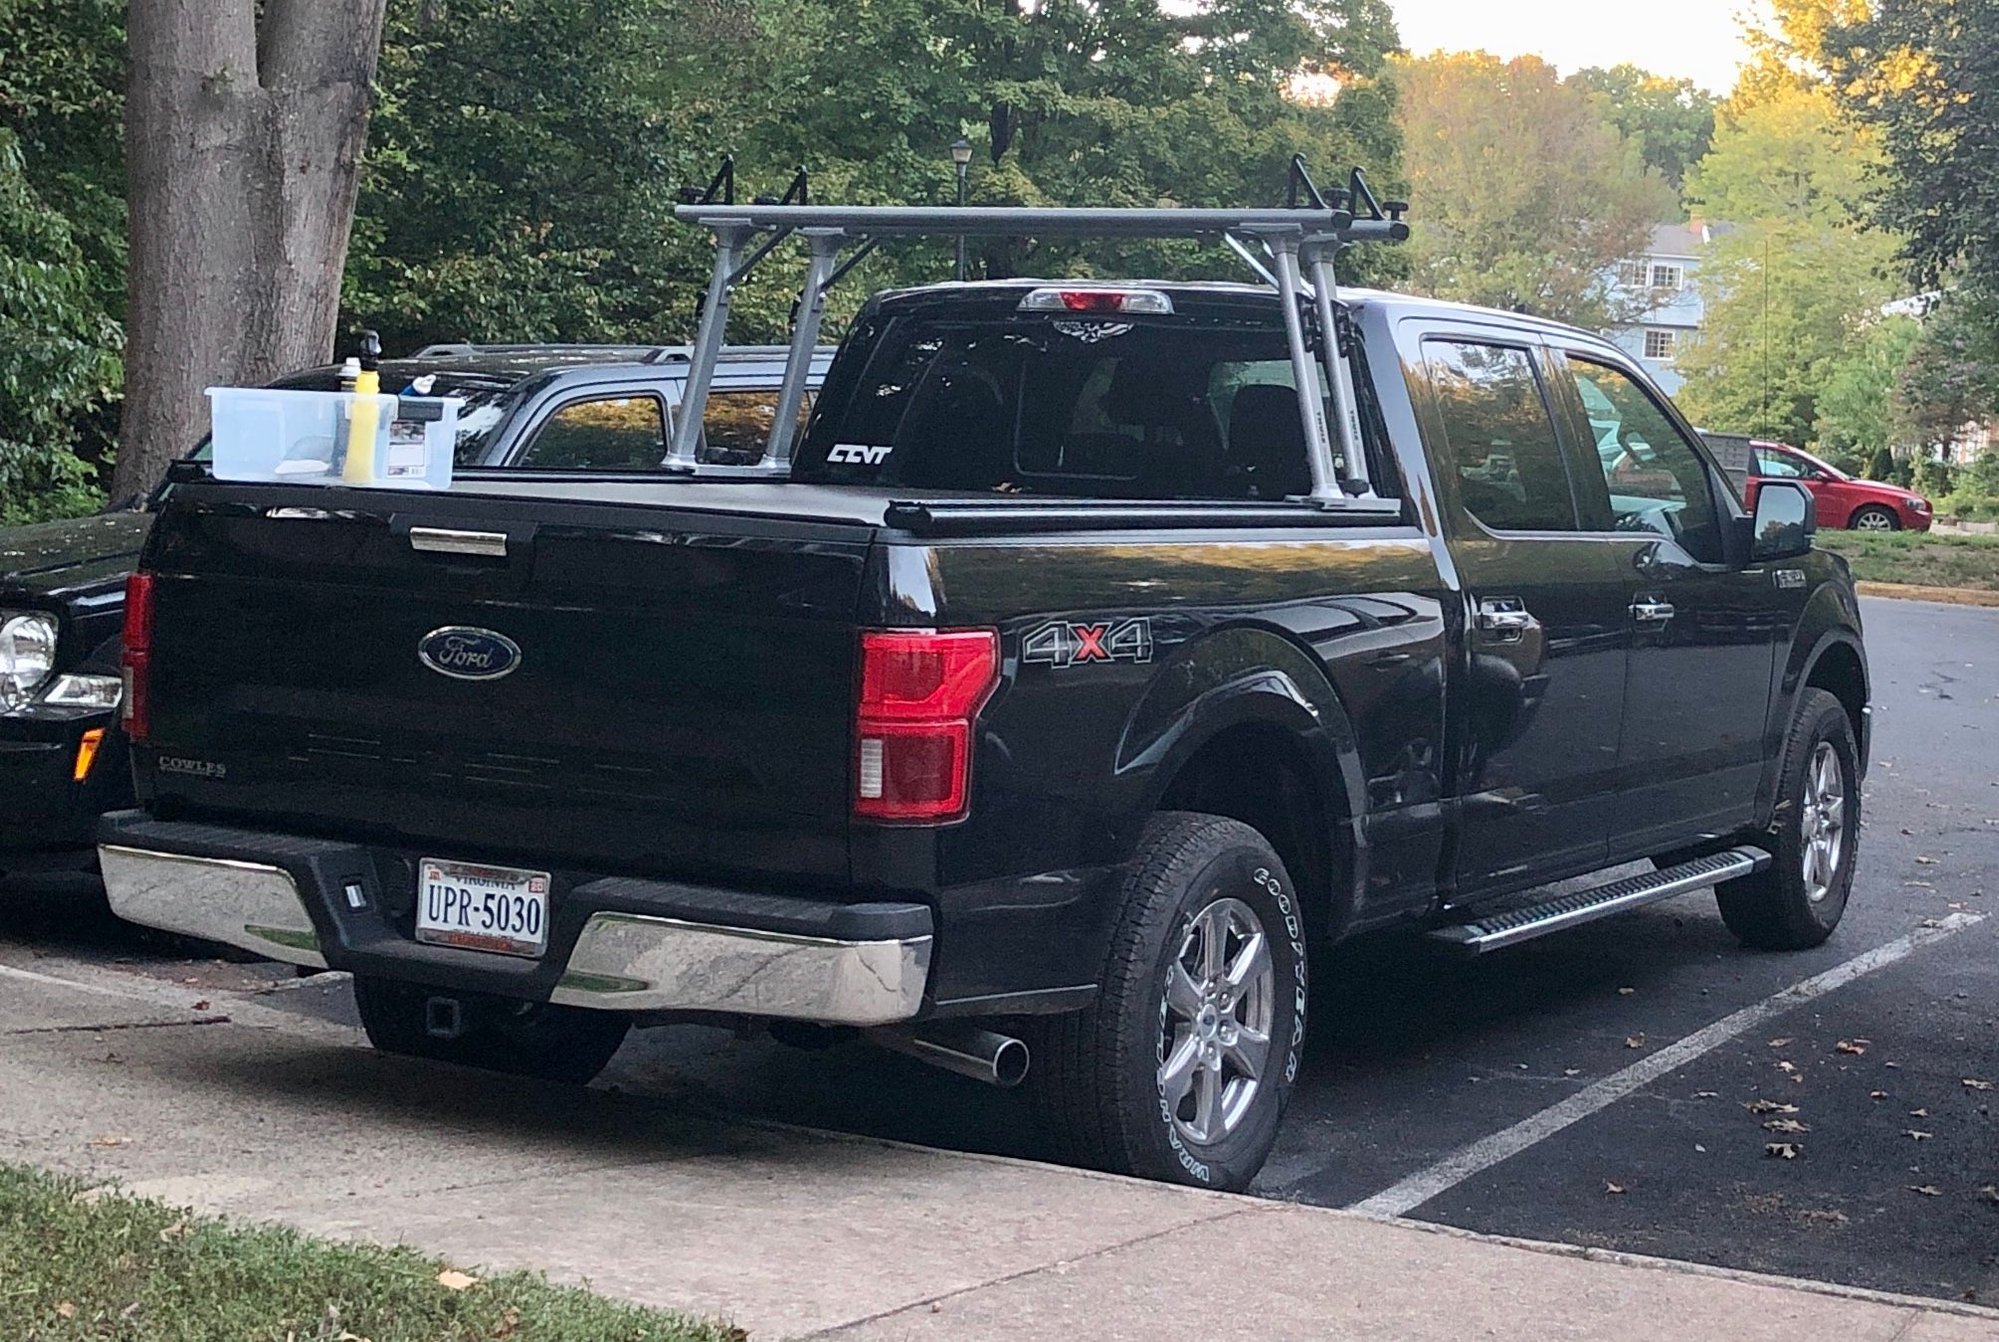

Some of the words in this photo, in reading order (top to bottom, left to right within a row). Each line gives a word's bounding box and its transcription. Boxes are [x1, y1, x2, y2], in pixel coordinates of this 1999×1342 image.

[439, 636, 494, 668] Ford
[159, 756, 227, 778] COWLES
[428, 884, 541, 936] UPR-5030
